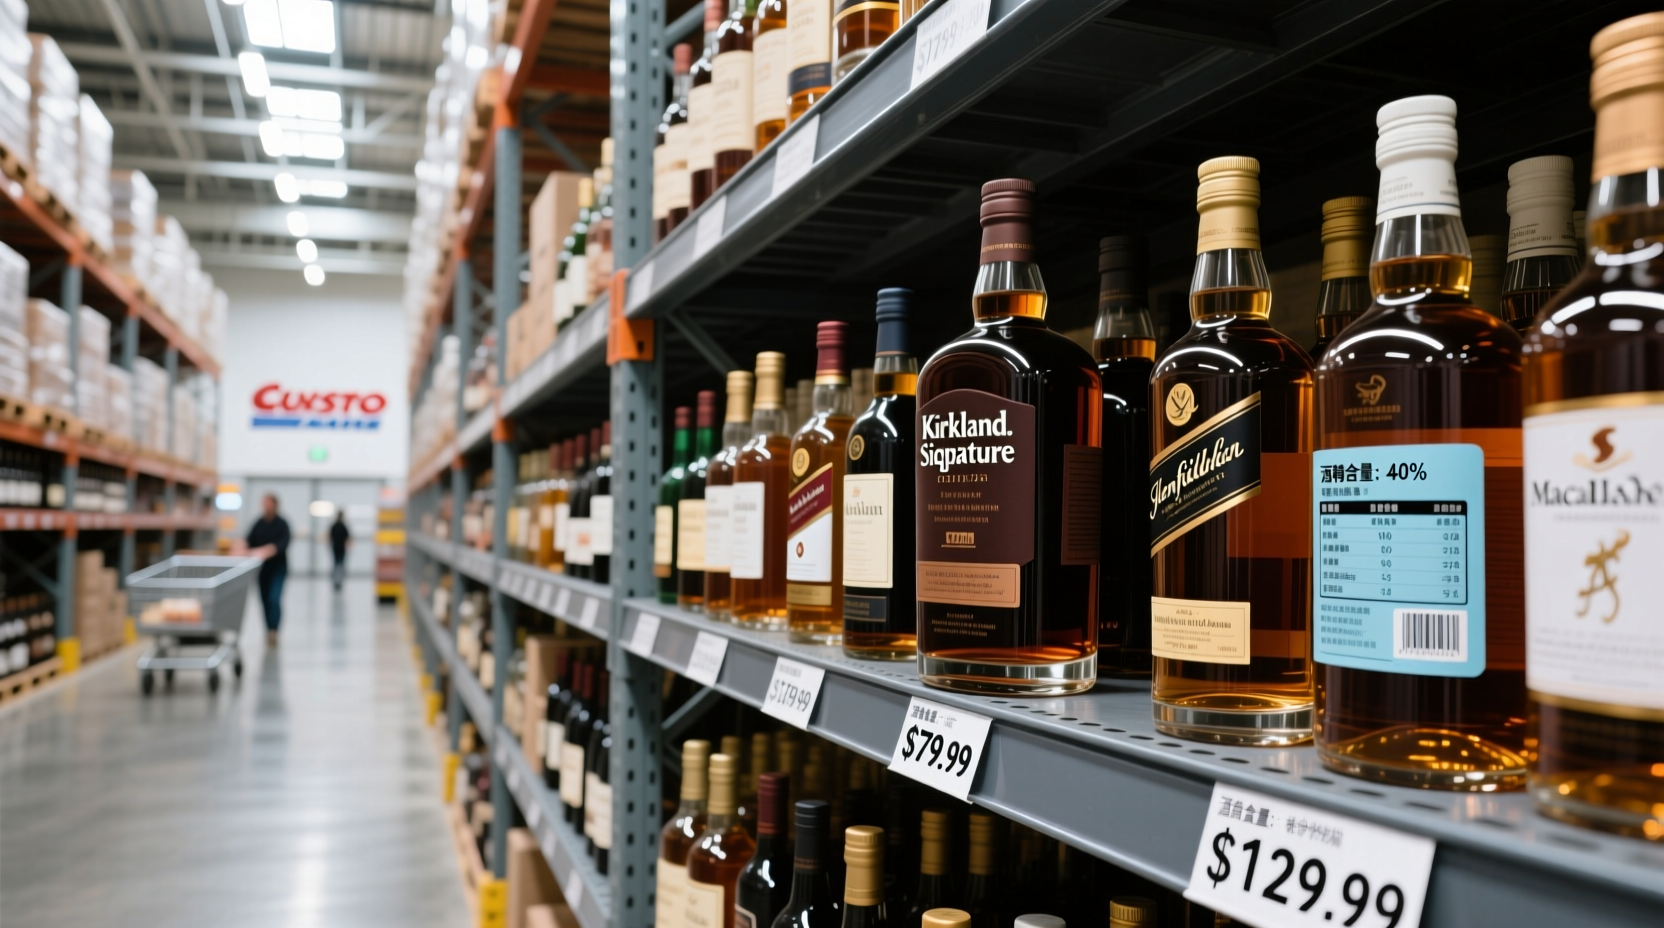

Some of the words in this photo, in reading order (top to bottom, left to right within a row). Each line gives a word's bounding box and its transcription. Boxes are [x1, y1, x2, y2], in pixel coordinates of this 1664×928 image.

[1386, 462, 1427, 481] 40%
[902, 724, 973, 777] $79.99
[1206, 827, 1405, 928] $129.99
